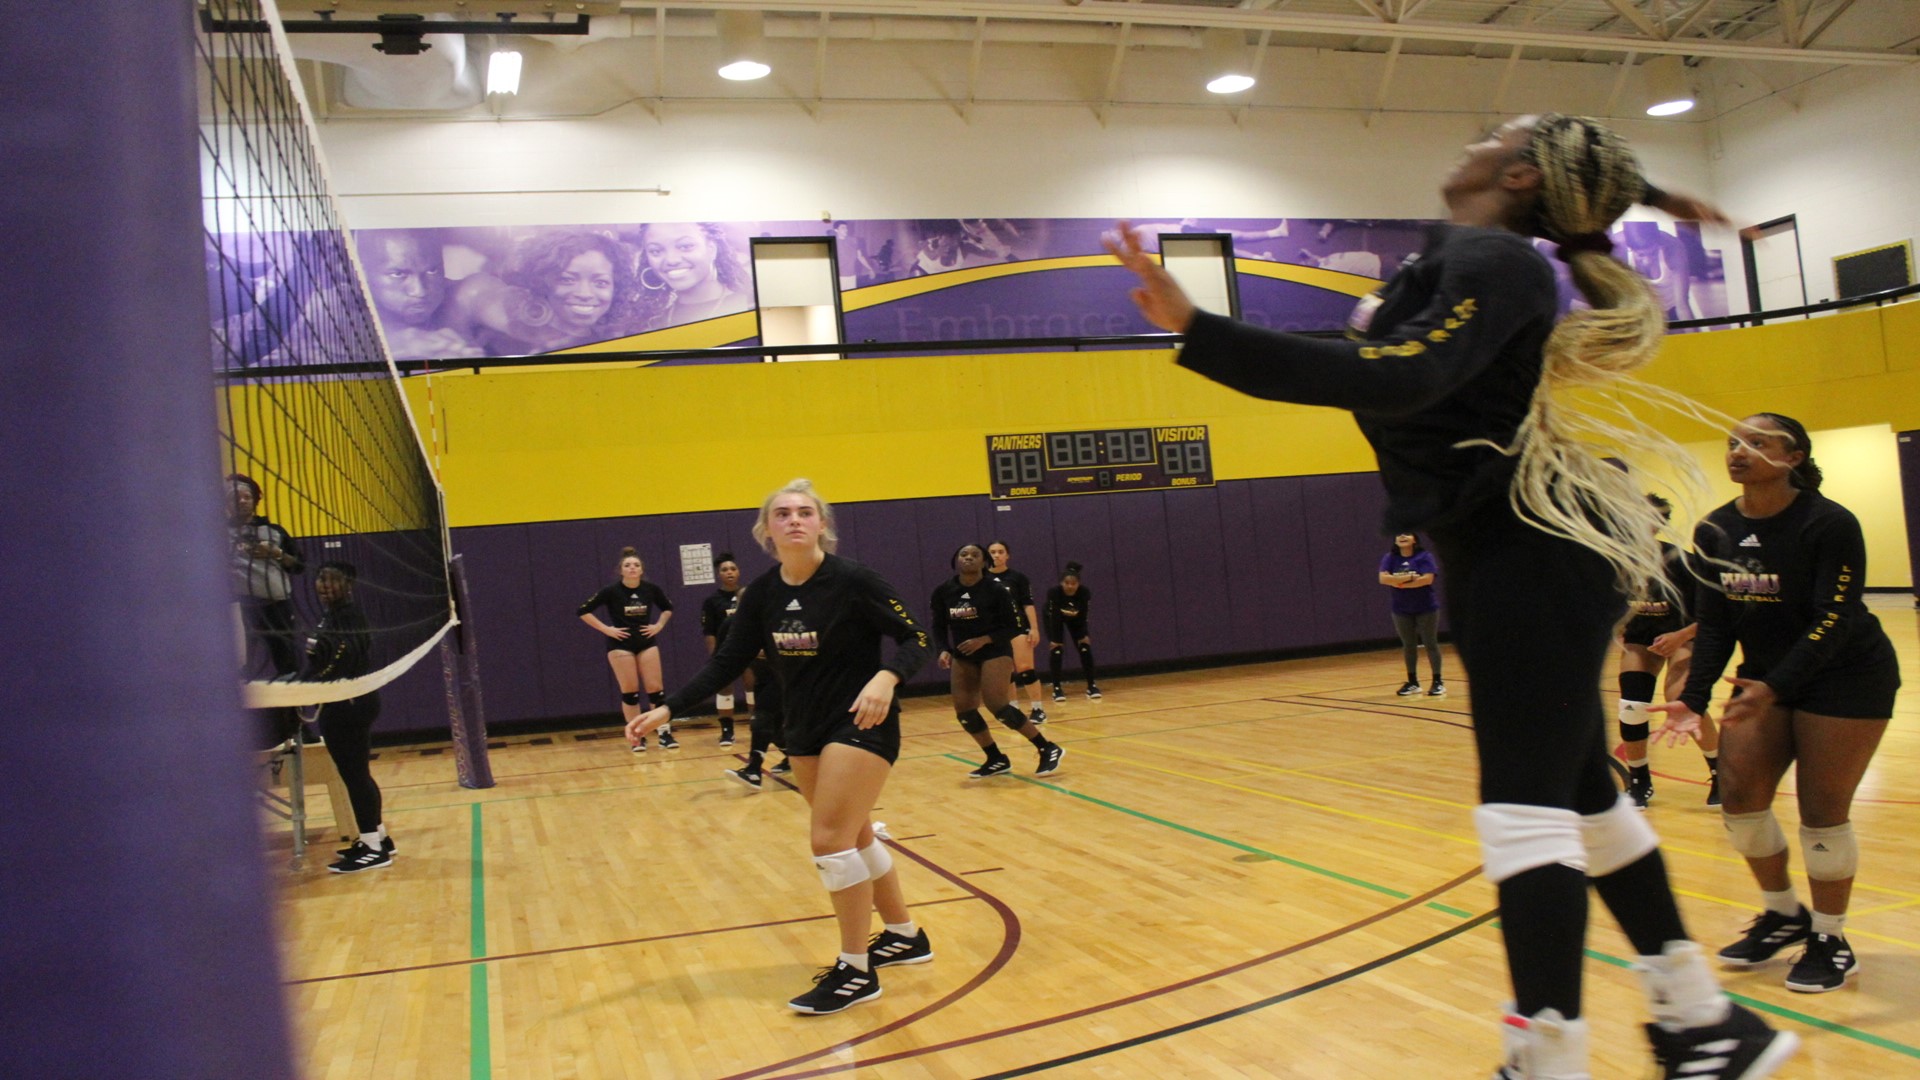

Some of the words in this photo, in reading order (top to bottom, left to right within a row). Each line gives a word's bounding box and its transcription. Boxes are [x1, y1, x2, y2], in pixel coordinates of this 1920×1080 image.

[896, 303, 1130, 340] Embrace
[1156, 427, 1205, 442] VISITOR
[991, 434, 1042, 450] PANTHERS
[1115, 473, 1142, 482] PERIOD
[1171, 477, 1197, 485] BONUS
[1010, 486, 1037, 495] BONUS
[1726, 594, 1782, 602] OLLEYBALL
